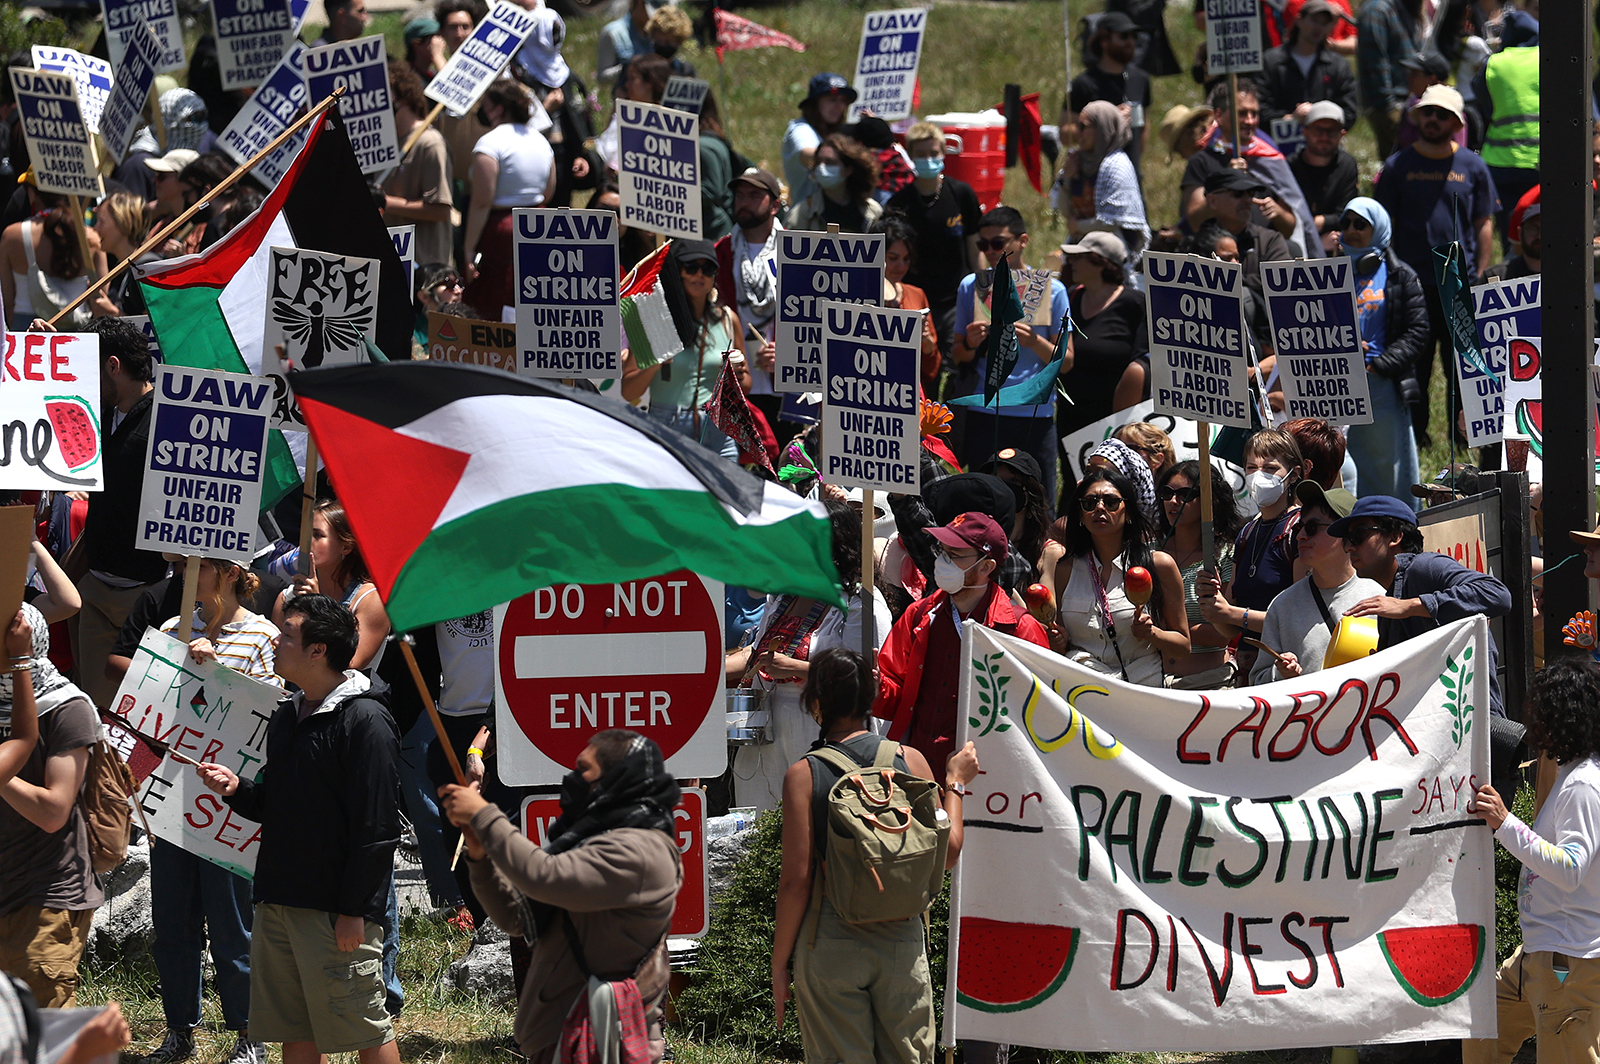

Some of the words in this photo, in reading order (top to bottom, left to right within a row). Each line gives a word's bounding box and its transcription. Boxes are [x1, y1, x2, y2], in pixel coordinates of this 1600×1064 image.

[109, 1, 172, 27] STRIKE
[493, 4, 535, 33] UAW
[1208, 0, 1255, 17] STRIKE
[219, 10, 288, 35] STRIKE
[868, 13, 924, 31] UAW
[1214, 21, 1250, 35] UNFAIR
[135, 20, 161, 67] UAW
[230, 33, 284, 51] UNFAIR
[486, 27, 510, 49] ON
[879, 35, 902, 53] ON
[1217, 38, 1249, 50] LABOR
[39, 50, 106, 72] UAW
[235, 49, 282, 67] LABOR
[306, 40, 381, 72] UAW
[463, 38, 509, 69] STRIKE
[861, 52, 916, 73] STRIKE
[1211, 54, 1259, 67] PRACTICE
[131, 54, 145, 79] ON
[226, 66, 274, 83] PRACT
[456, 60, 487, 80] UNFAIR
[13, 73, 72, 97] UAW
[118, 66, 145, 113] STRIKE
[334, 71, 363, 92] ON
[447, 71, 476, 91] LABOR
[667, 82, 704, 99] UAW
[865, 74, 905, 88] UNFAIR
[339, 88, 387, 118] RIKE
[432, 80, 473, 108] PRACTICE
[864, 88, 901, 100] LABOR
[37, 99, 63, 119] ON
[621, 105, 694, 135] UAW
[853, 101, 907, 114] PRACTICE
[25, 116, 87, 141] STRIKE
[345, 115, 382, 136] FAIR
[37, 142, 84, 159] UNFAIR
[243, 125, 284, 163] LABR
[352, 133, 382, 150] BOR
[644, 134, 672, 157] ON
[43, 159, 86, 174] LABOR
[225, 130, 283, 184] PRACICE
[356, 146, 396, 168] CTICE
[623, 151, 695, 181] STRIKE
[38, 172, 99, 191] PRACTICE
[633, 177, 687, 200] UNFAIR
[637, 193, 685, 215] LABOR
[518, 214, 613, 240] UAW
[626, 206, 698, 233] PRACTICE
[548, 249, 584, 273] ON
[783, 236, 881, 263] UAW
[271, 251, 372, 312] FREE
[523, 275, 613, 300] STRIKE
[812, 270, 849, 294] ON
[1148, 258, 1238, 293] UAW
[1265, 264, 1348, 292] UAW
[533, 308, 604, 328] UNFAIR
[1180, 294, 1212, 321] ON
[1294, 300, 1326, 324] ON
[471, 324, 516, 348] END
[828, 307, 917, 343] UAW
[1156, 316, 1240, 351] STRIKE
[1278, 325, 1355, 350] STRIKE
[1484, 317, 1519, 343] ON
[538, 330, 601, 349] LABOR
[2, 333, 80, 382] REE
[431, 343, 516, 373] OCCUPA
[524, 351, 617, 370] PRACTICE
[854, 349, 887, 376] ON
[1167, 349, 1232, 377] UNFAIR
[1290, 358, 1350, 377] UNFAIR
[162, 372, 270, 410] UAW
[830, 375, 913, 408] STRIKE
[1172, 370, 1230, 397] LABOR
[1296, 378, 1350, 397] LABOR
[1159, 389, 1246, 419] PRACTICE
[1290, 398, 1367, 417] PRACTICE
[189, 413, 231, 442] ON
[840, 411, 904, 438] UNFAIR
[155, 439, 258, 475] STRIKE
[844, 434, 900, 460] LABOR
[830, 456, 915, 484] PRACTICE
[163, 476, 242, 504] UNFAIR
[164, 500, 235, 527] LABOR
[144, 520, 250, 552] PRACTICE
[534, 583, 585, 619] DO
[613, 581, 688, 617] NOT
[550, 691, 672, 729] ENTER
[1022, 673, 1123, 760] UC
[1176, 672, 1420, 765] LABOR
[1070, 785, 1403, 889] PALESTINE
[1412, 774, 1479, 814] SAYS
[1110, 908, 1349, 1009] DIVEST
